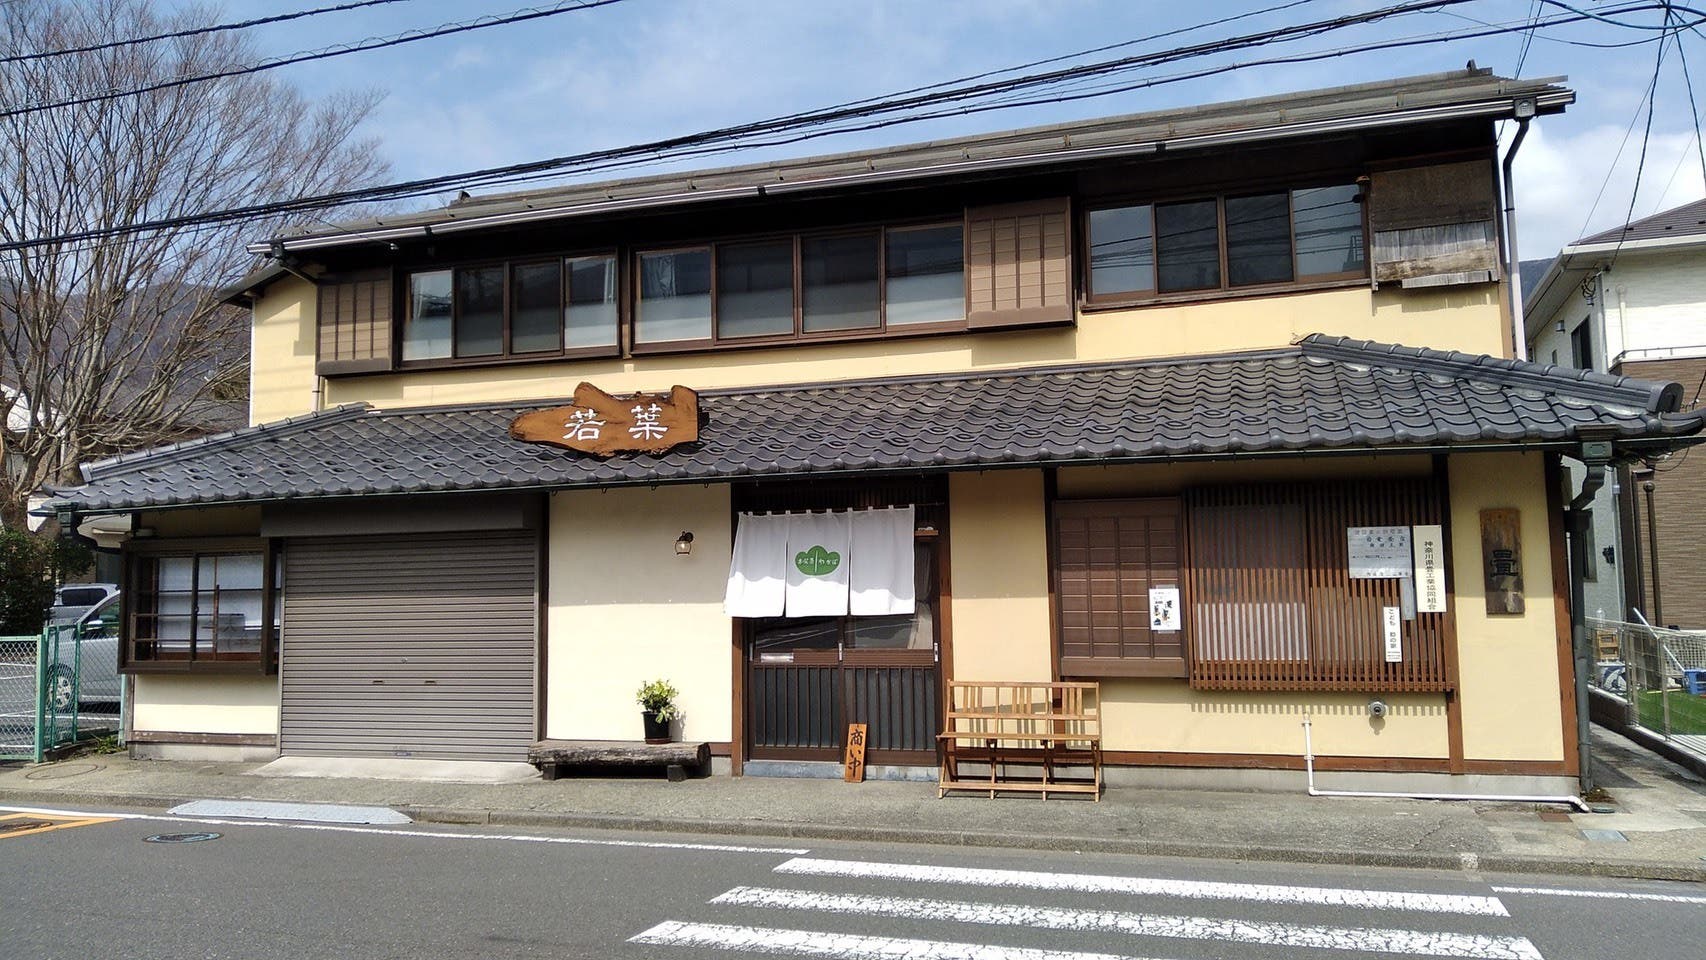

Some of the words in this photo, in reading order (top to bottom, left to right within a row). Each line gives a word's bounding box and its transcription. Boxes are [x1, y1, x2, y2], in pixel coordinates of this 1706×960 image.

[562, 403, 668, 440] 若葉
[1490, 549, 1519, 577] 畳
[848, 729, 863, 777] 商い中
